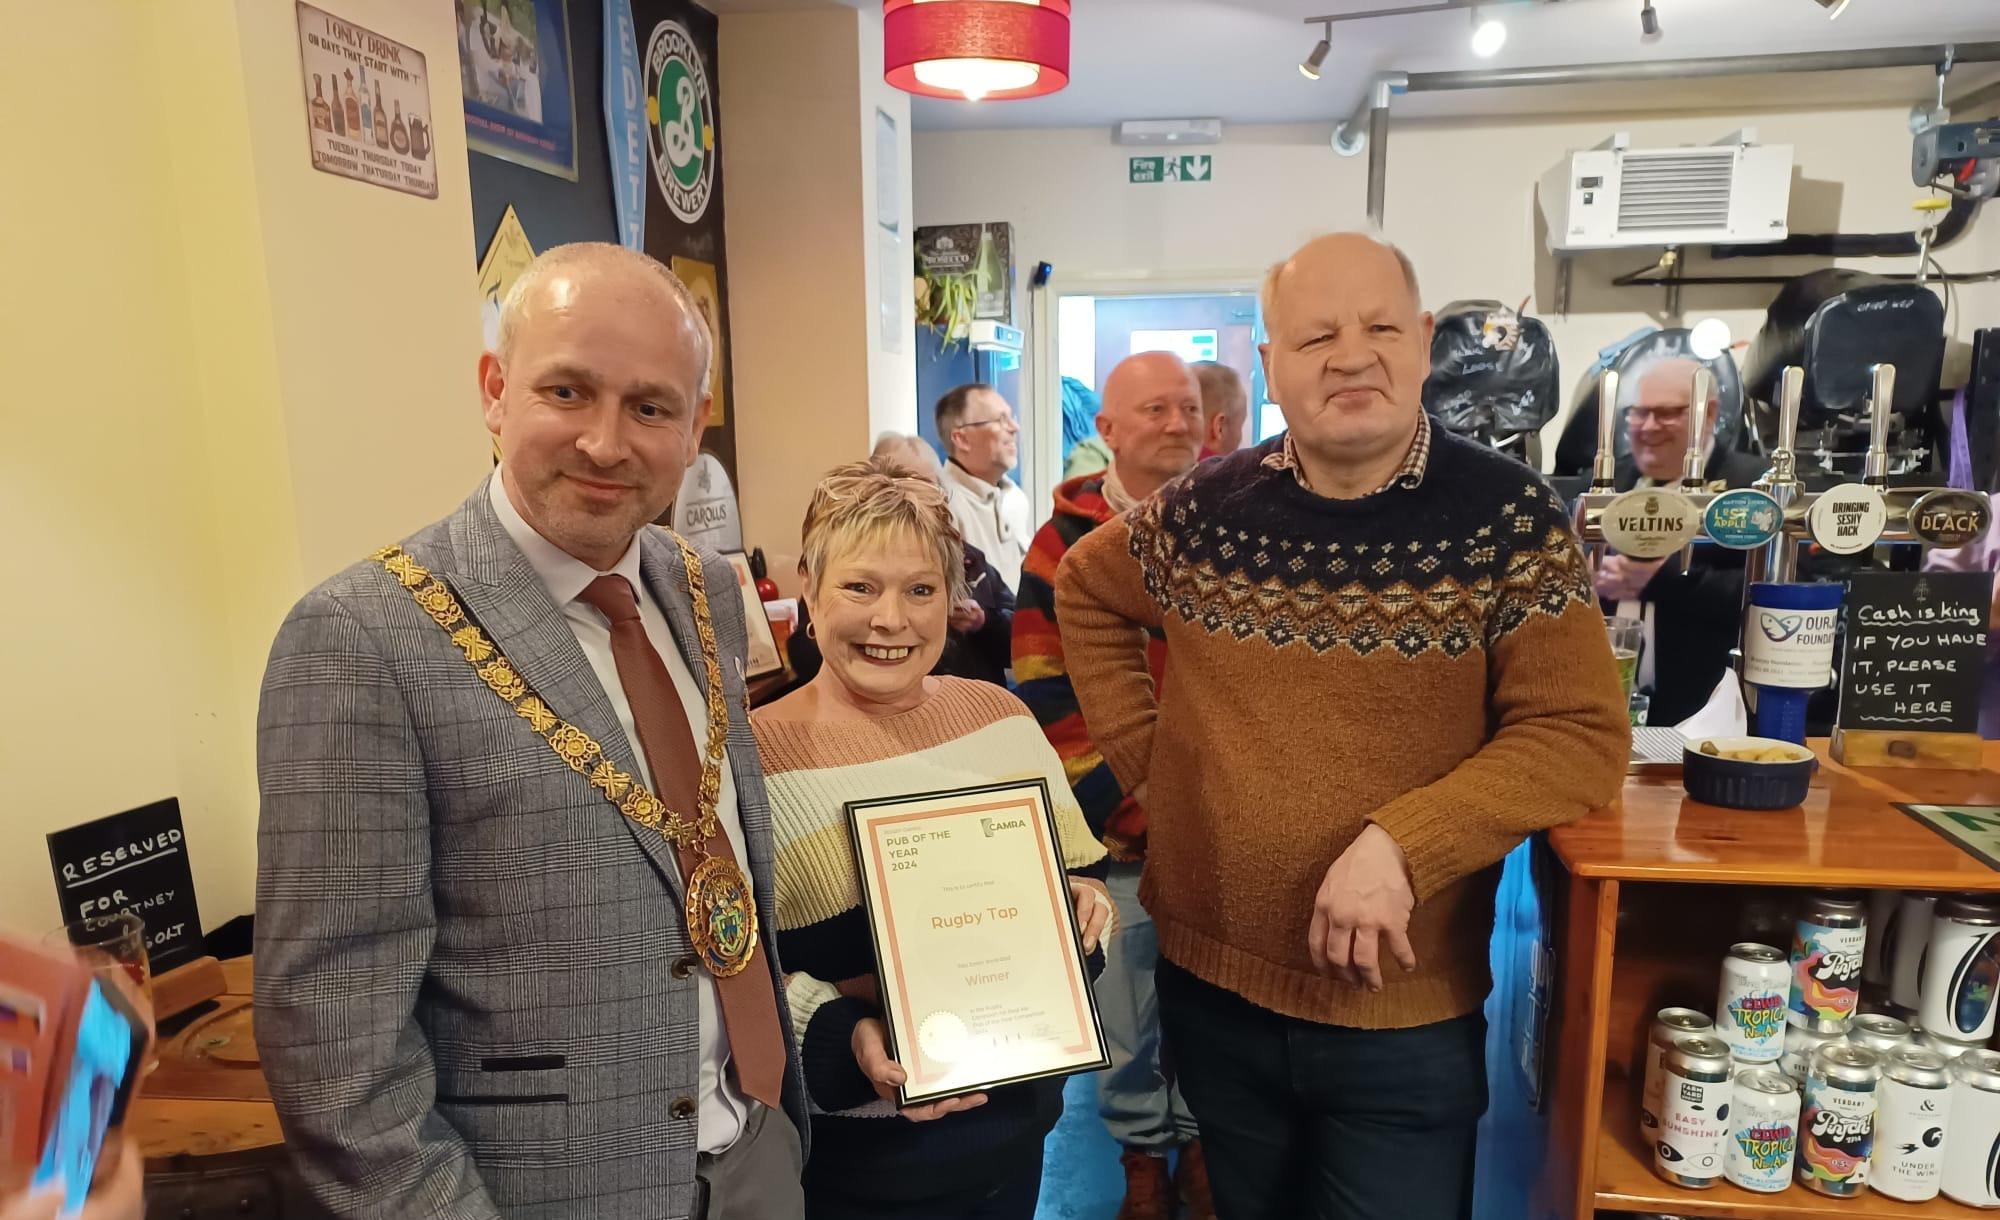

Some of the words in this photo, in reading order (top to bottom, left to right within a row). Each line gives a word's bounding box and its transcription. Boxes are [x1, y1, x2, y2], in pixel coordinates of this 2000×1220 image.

[333, 21, 364, 48] ONLY
[368, 37, 402, 64] DRINK
[308, 32, 320, 46] ON
[322, 39, 342, 56] DAYS
[343, 46, 362, 64] THAT
[364, 58, 388, 74] START
[390, 66, 409, 81] WITH
[652, 33, 707, 100] BROOKLYN
[316, 150, 358, 172] TOMORROW
[327, 138, 358, 158] TUESDAY
[362, 150, 398, 169] THURSDAY
[400, 160, 422, 175] TODAY
[658, 152, 708, 214] BREWERY
[686, 504, 727, 528] CAROLUS
[1714, 519, 1746, 529] APPLE
[1921, 514, 1980, 532] BLACK
[1618, 517, 1684, 532] VELTINS
[1858, 604, 1912, 620] Cash
[1918, 608, 1936, 619] is
[1940, 601, 1980, 626] king
[1854, 636, 1876, 650] IF
[1886, 634, 1930, 650] YOU
[1886, 660, 1957, 672] PLEASE
[1855, 683, 1896, 696] USE
[1909, 684, 1932, 695] IT
[1894, 700, 1952, 714] HERE
[989, 820, 1026, 831] CAMRA
[886, 836, 909, 846] PUB
[912, 834, 927, 843] OF
[928, 830, 950, 840] THE
[62, 828, 182, 882] RESERVED
[888, 848, 918, 859] YEAR
[892, 860, 918, 872] 2024
[80, 889, 128, 919] FOR
[932, 912, 982, 930] Rugby
[986, 906, 1018, 920] Tap
[964, 971, 1010, 986] Winner
[1676, 1112, 1706, 1126] EASY
[1892, 1166, 1913, 1176] THE
[1902, 1160, 1935, 1169] UNDER
